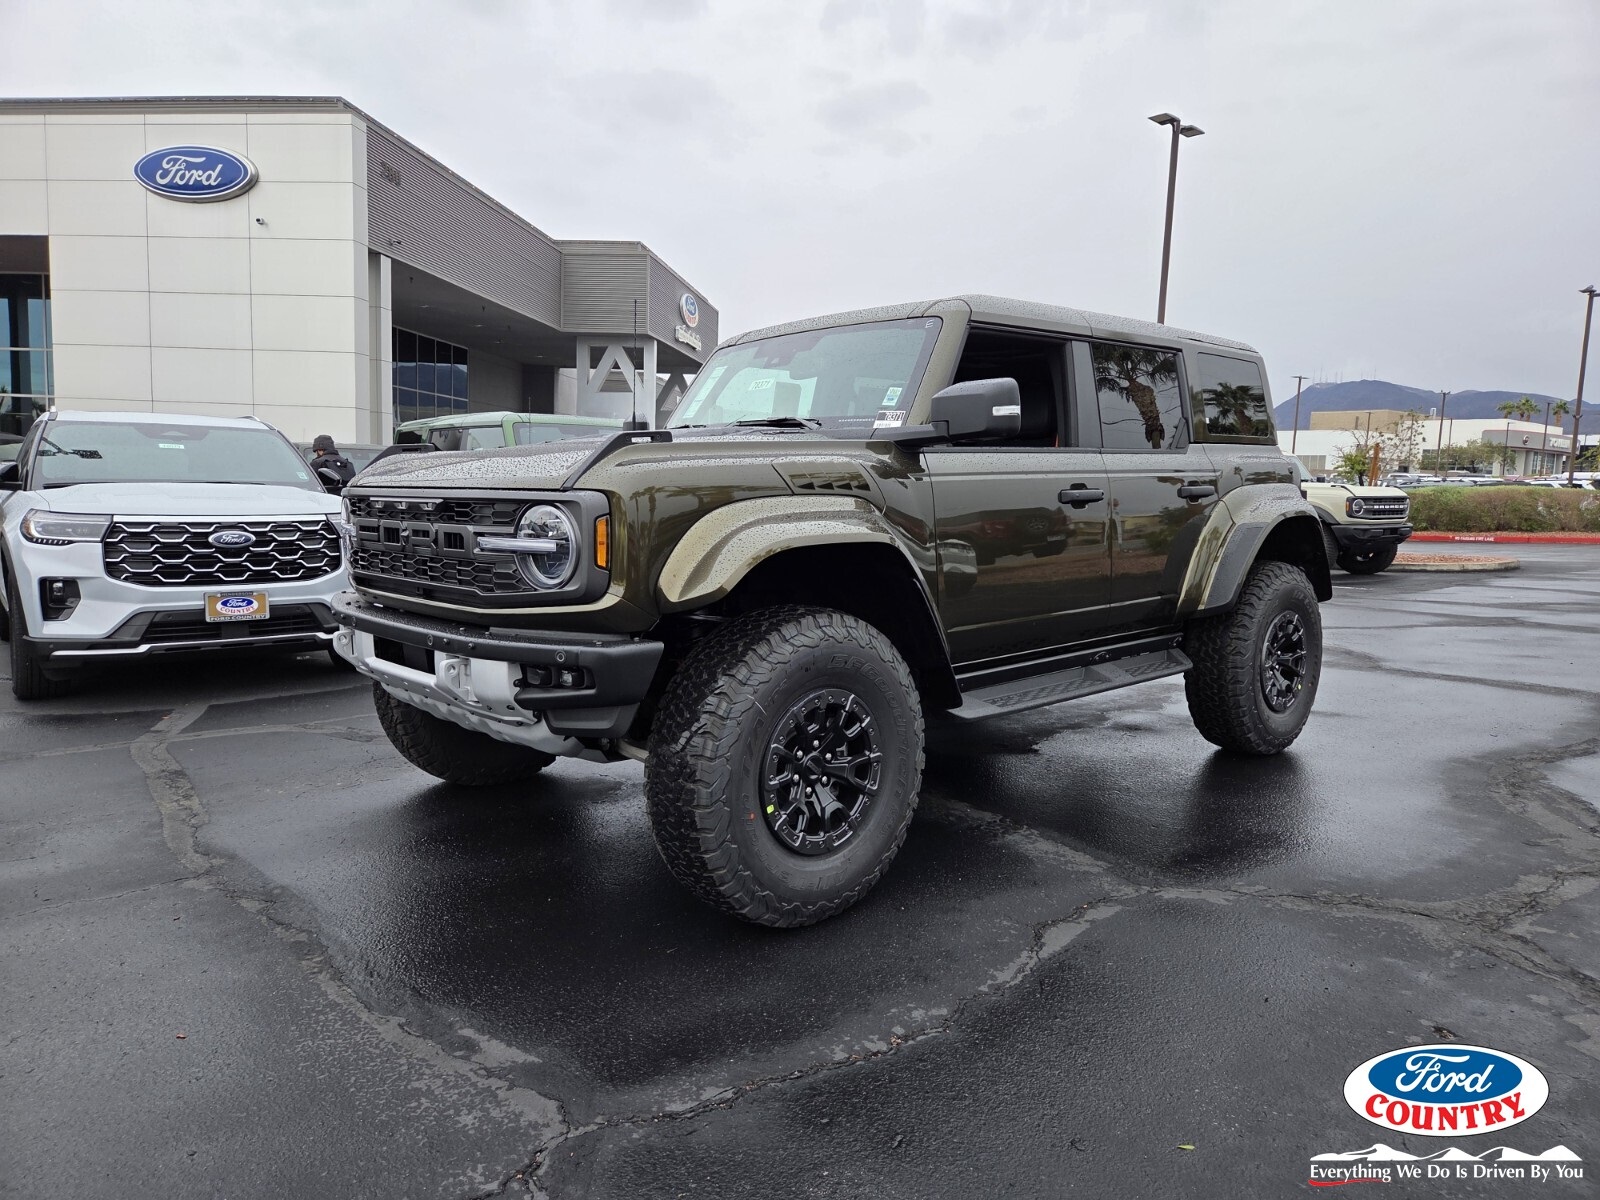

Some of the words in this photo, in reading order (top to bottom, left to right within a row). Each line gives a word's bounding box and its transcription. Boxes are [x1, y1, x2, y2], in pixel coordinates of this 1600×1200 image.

[155, 154, 223, 186] Ford
[220, 534, 246, 544] Ford
[353, 517, 476, 559] FORD
[226, 598, 247, 606] Ford
